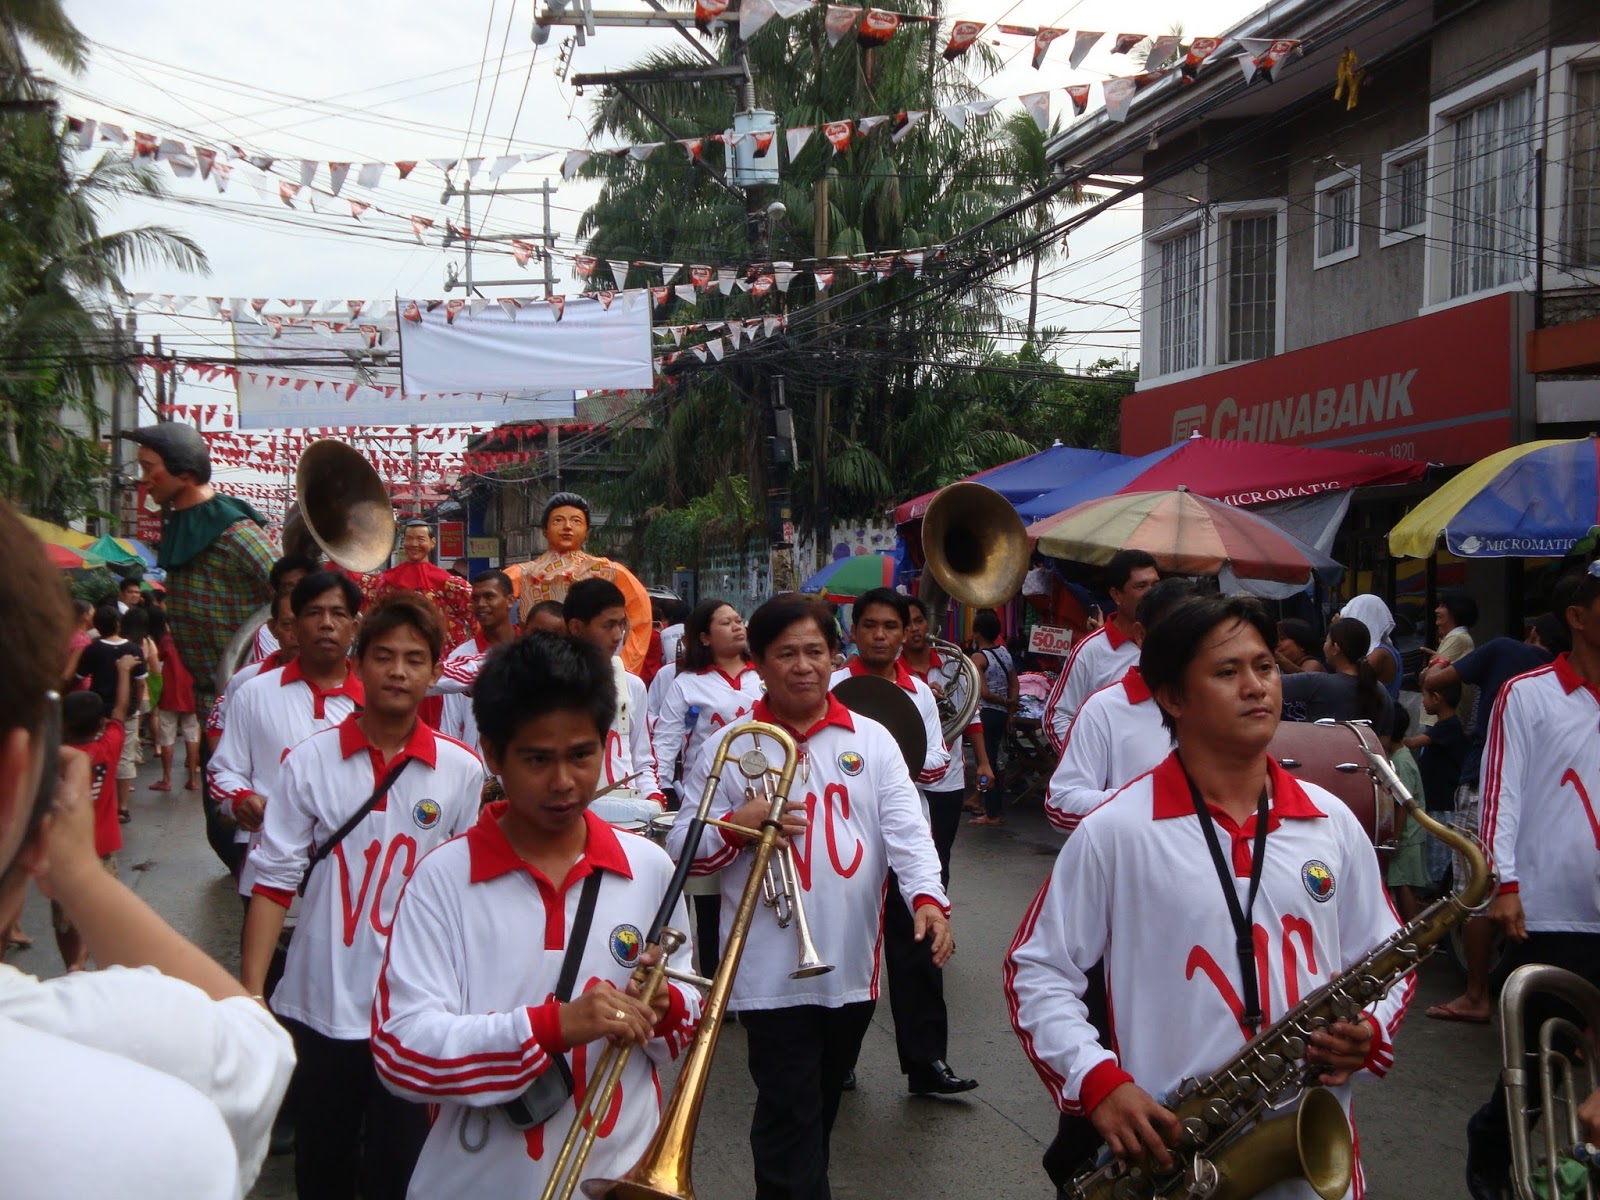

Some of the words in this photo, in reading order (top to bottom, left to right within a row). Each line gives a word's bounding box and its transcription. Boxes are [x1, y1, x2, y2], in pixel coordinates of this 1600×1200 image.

[1211, 368, 1419, 443] CHINABANK
[1389, 441, 1416, 461] 1920
[1485, 538, 1578, 552] MICROMATIC
[1031, 631, 1071, 651] 50.00
